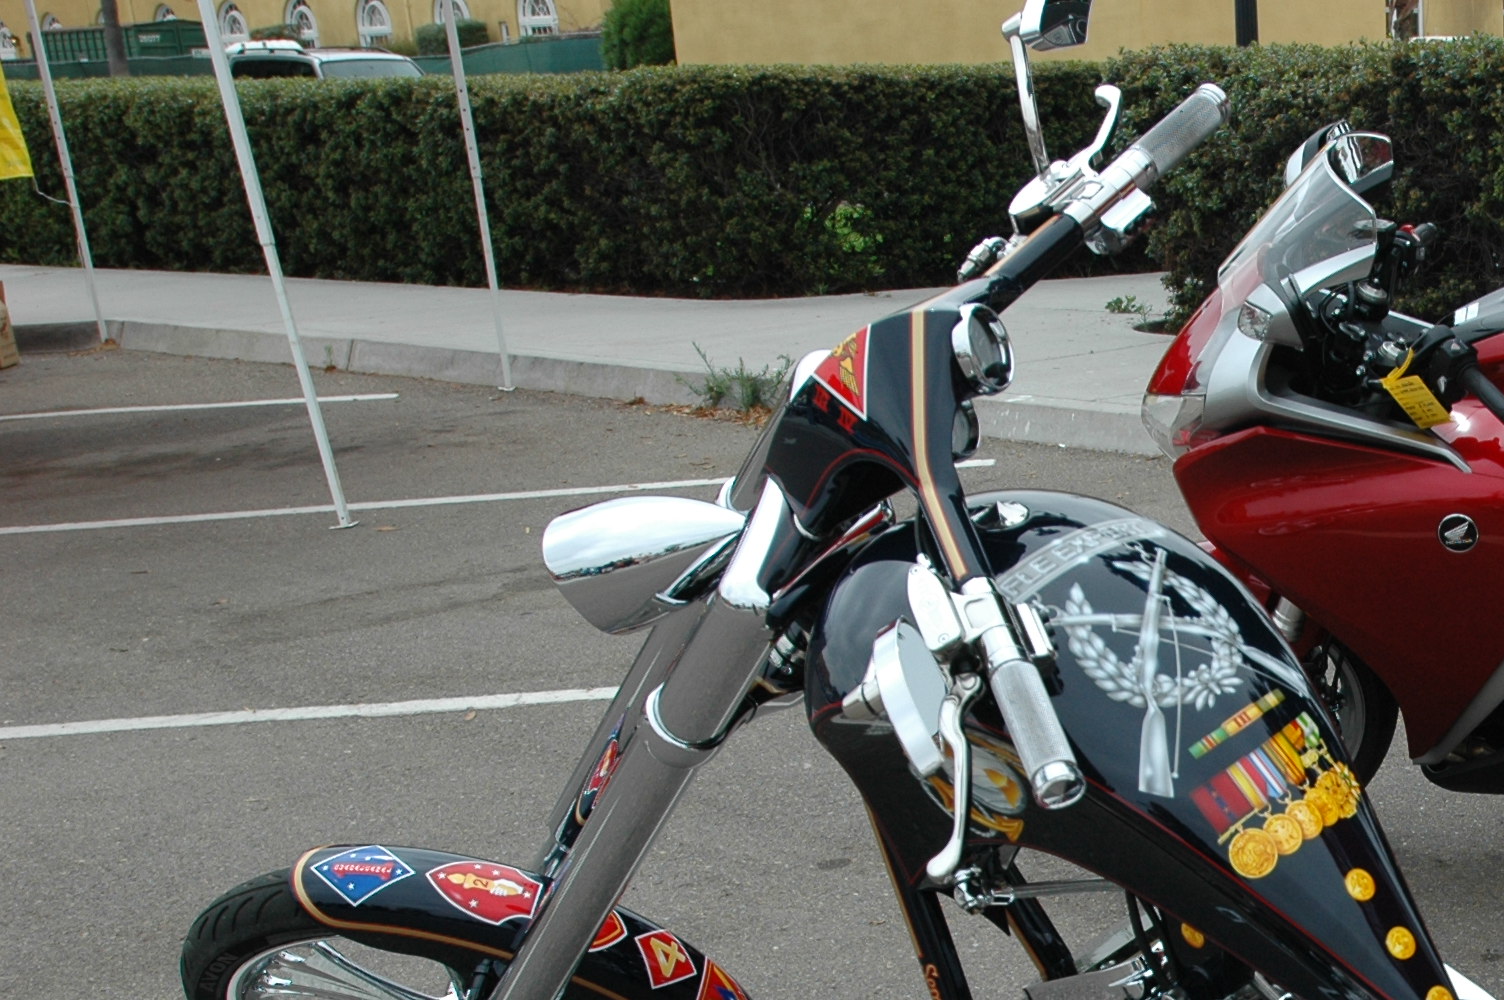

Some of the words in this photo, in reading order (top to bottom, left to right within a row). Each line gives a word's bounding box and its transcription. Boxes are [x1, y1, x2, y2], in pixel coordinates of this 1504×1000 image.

[1001, 554, 1057, 598] FLE
[200, 951, 239, 993] AVON
[650, 936, 686, 978] 4
